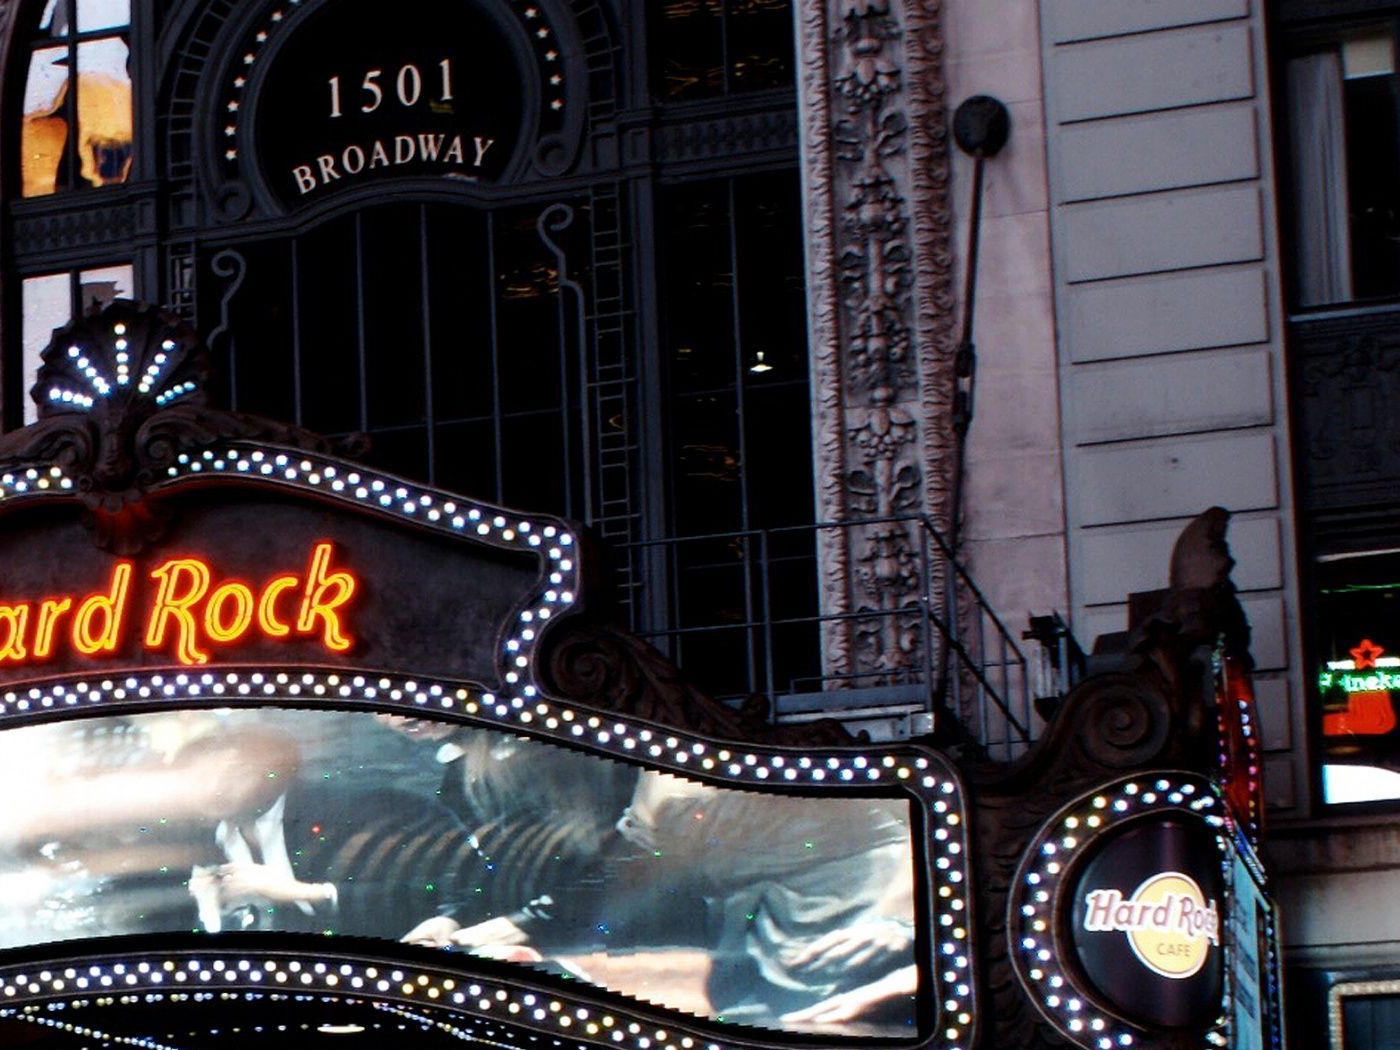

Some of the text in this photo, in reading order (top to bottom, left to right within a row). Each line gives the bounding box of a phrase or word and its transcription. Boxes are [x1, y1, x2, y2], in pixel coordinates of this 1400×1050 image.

[328, 59, 453, 117] 1501
[292, 134, 494, 194] BROADWAY
[144, 543, 356, 665] Rock
[1086, 890, 1174, 931] Hard
[1156, 942, 1191, 958] CAFE
